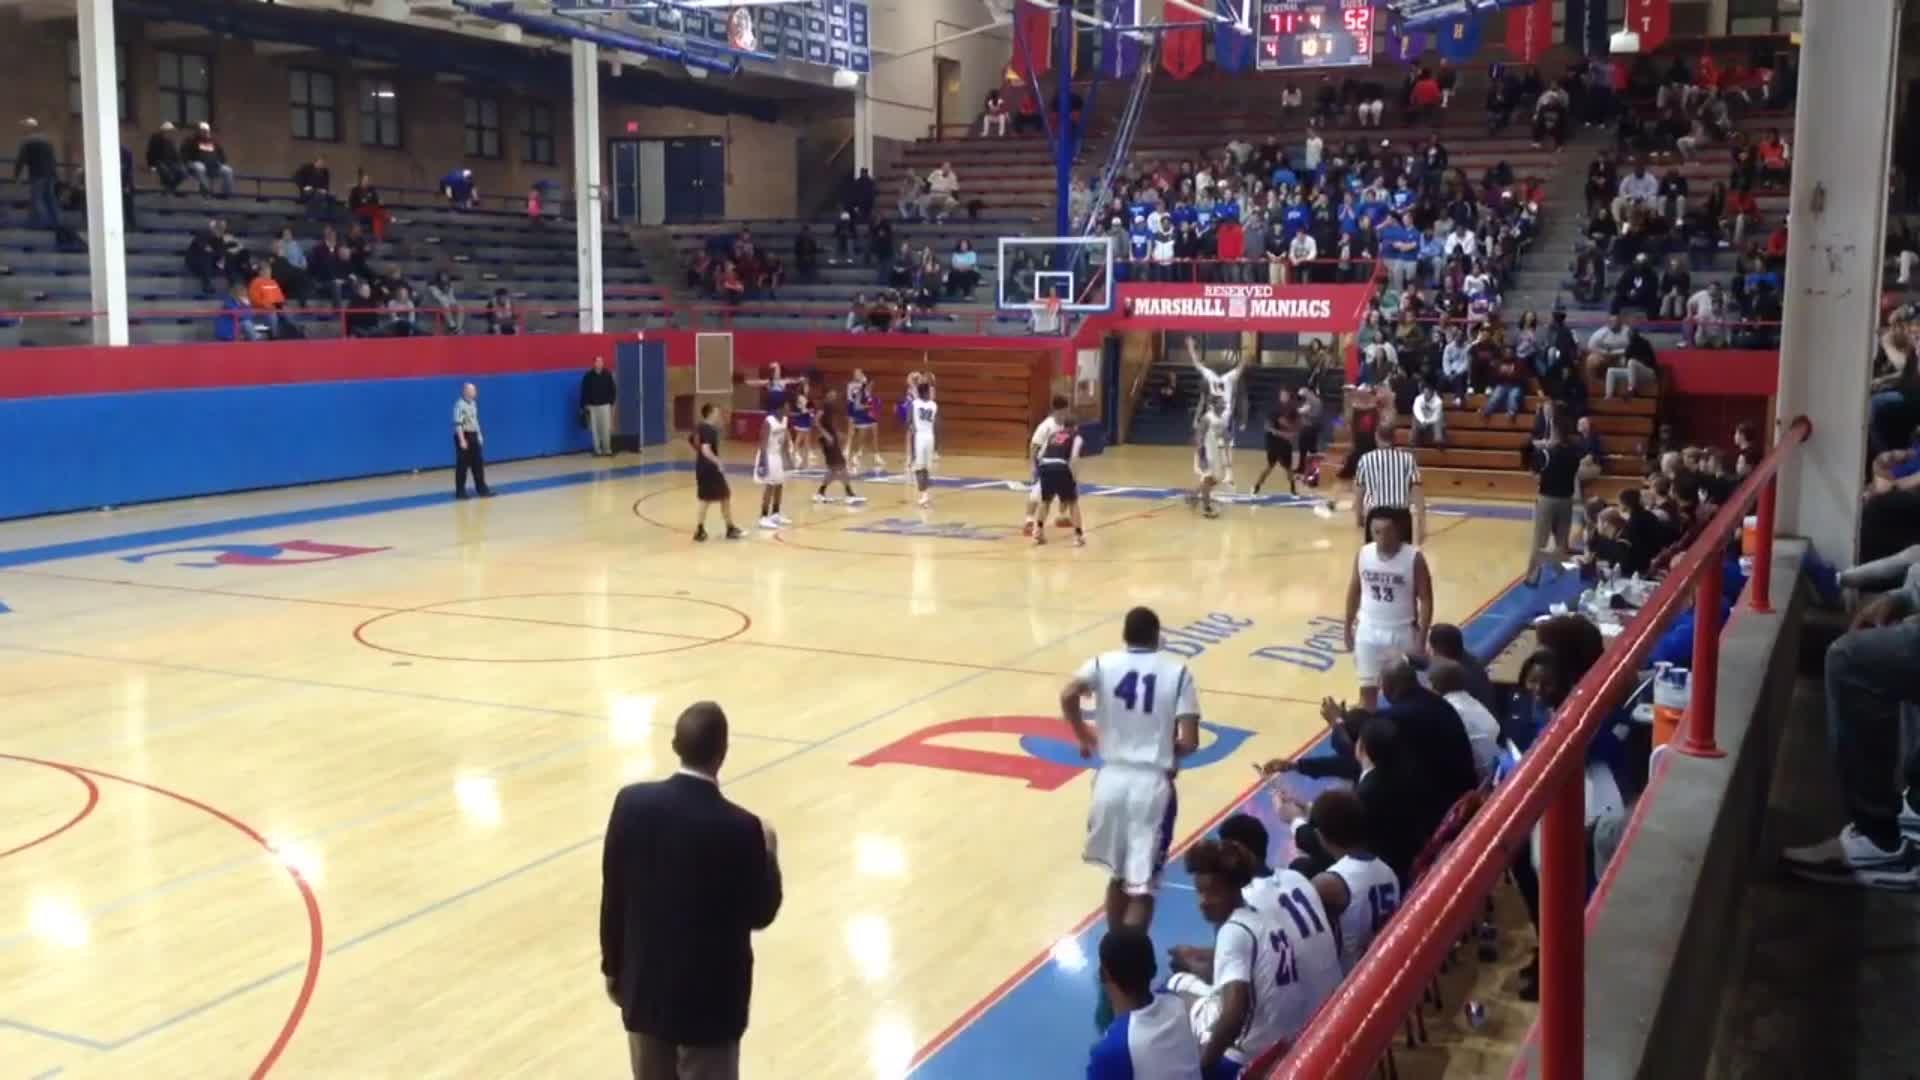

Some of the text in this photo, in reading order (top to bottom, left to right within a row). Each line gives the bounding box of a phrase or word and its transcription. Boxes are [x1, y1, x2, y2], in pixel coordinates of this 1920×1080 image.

[1270, 14, 1293, 33] 71
[1344, 9, 1369, 29] 52
[1266, 43, 1276, 56] 4
[1359, 37, 1368, 54] 3
[1204, 284, 1273, 298] RESERVED
[1134, 298, 1331, 318] MARSHALL MANIACS
[1113, 671, 1158, 714] 41
[1278, 887, 1325, 939] 11
